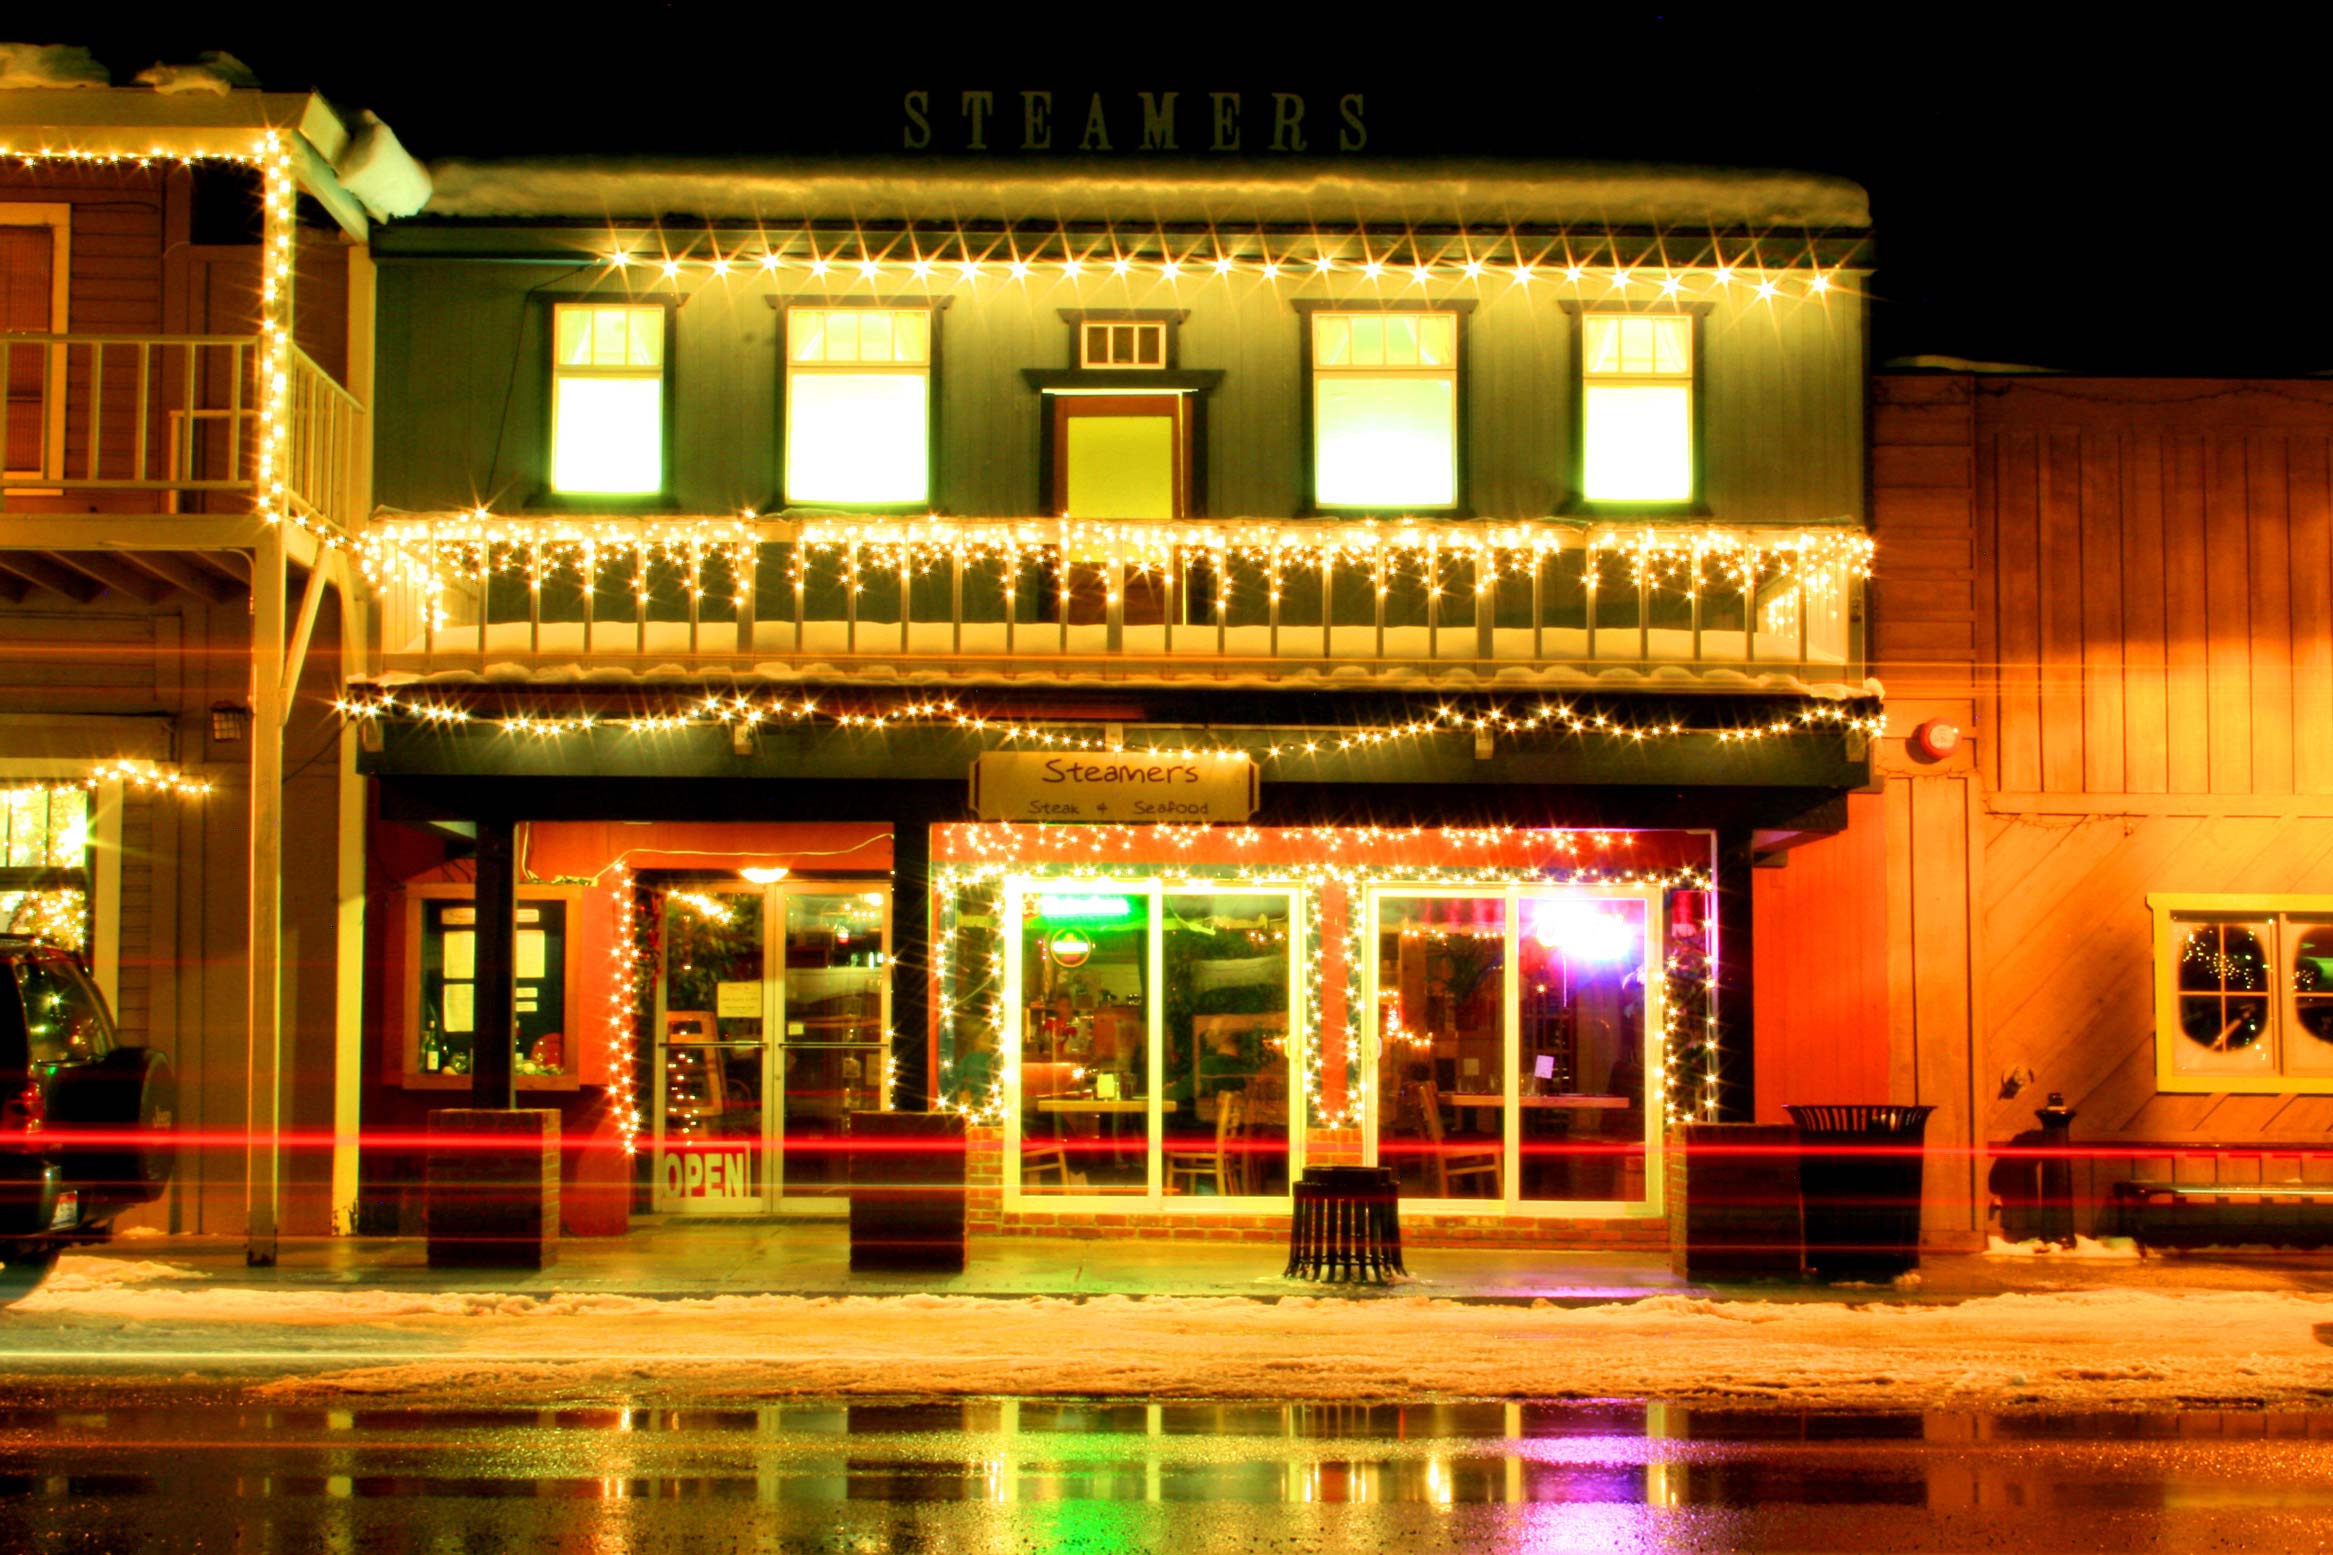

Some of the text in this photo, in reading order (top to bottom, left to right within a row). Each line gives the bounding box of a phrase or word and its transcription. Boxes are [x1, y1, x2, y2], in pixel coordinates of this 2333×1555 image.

[903, 91, 1368, 151] STEAMERS
[1042, 758, 1199, 784] Steamers
[1028, 800, 1080, 815] Steak
[1134, 800, 1209, 815] Seafood
[664, 1152, 744, 1198] OPEN
